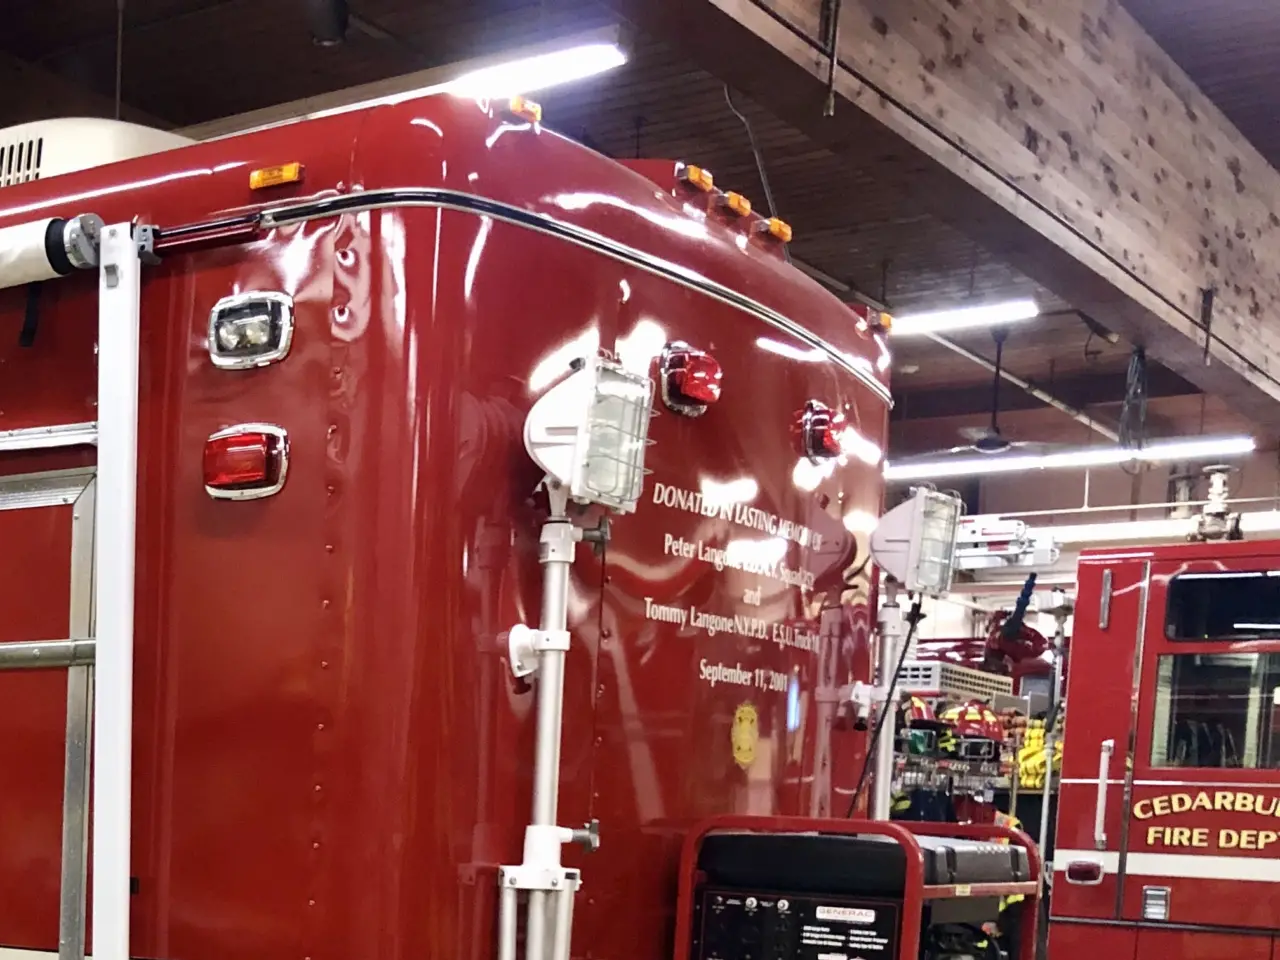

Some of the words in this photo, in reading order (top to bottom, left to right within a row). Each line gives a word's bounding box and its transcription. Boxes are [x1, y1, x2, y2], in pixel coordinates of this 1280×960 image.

[735, 502, 777, 535] LASTING
[777, 518, 812, 546] MEMOY
[664, 534, 696, 557] Peter
[698, 540, 741, 571] Lango
[743, 586, 761, 606] and
[644, 597, 688, 630] Tommy
[690, 606, 733, 636] Langone
[699, 658, 752, 687] September
[754, 670, 767, 691] 11,
[768, 673, 787, 692] 2001
[1133, 791, 1280, 820] CEDARBU
[1146, 826, 1210, 847] FIRE
[1218, 829, 1280, 850] DEP
[818, 908, 873, 918] GENERAC
